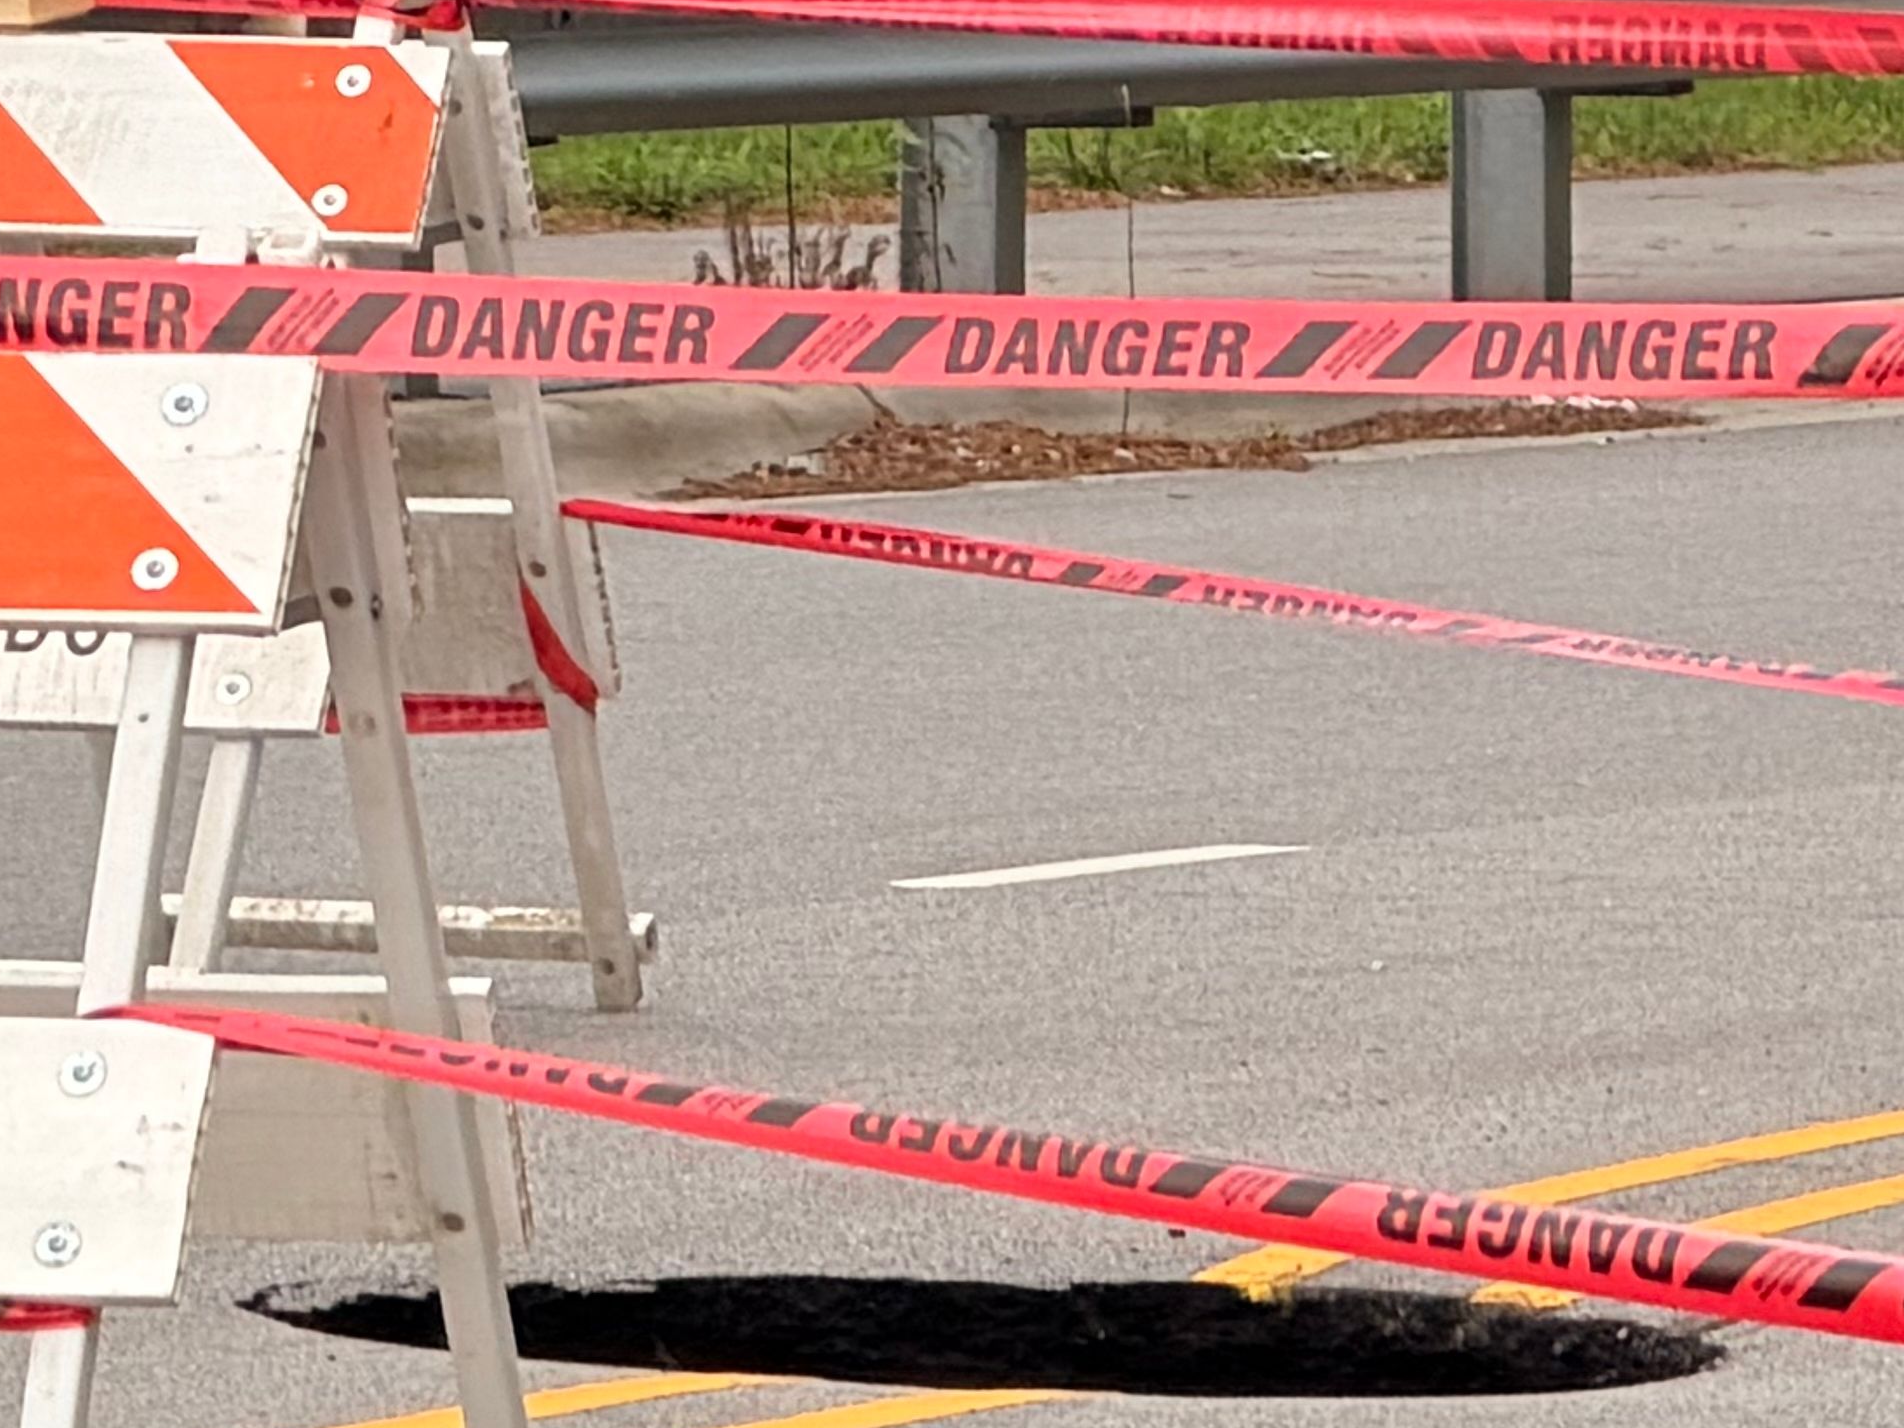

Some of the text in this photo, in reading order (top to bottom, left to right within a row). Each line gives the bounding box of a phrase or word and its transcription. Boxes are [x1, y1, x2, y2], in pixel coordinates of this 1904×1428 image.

[412, 294, 716, 365] DANGER
[945, 317, 1251, 377] DANGER
[1471, 318, 1778, 382] DANGER
[1378, 1187, 1685, 1285] DANGER
